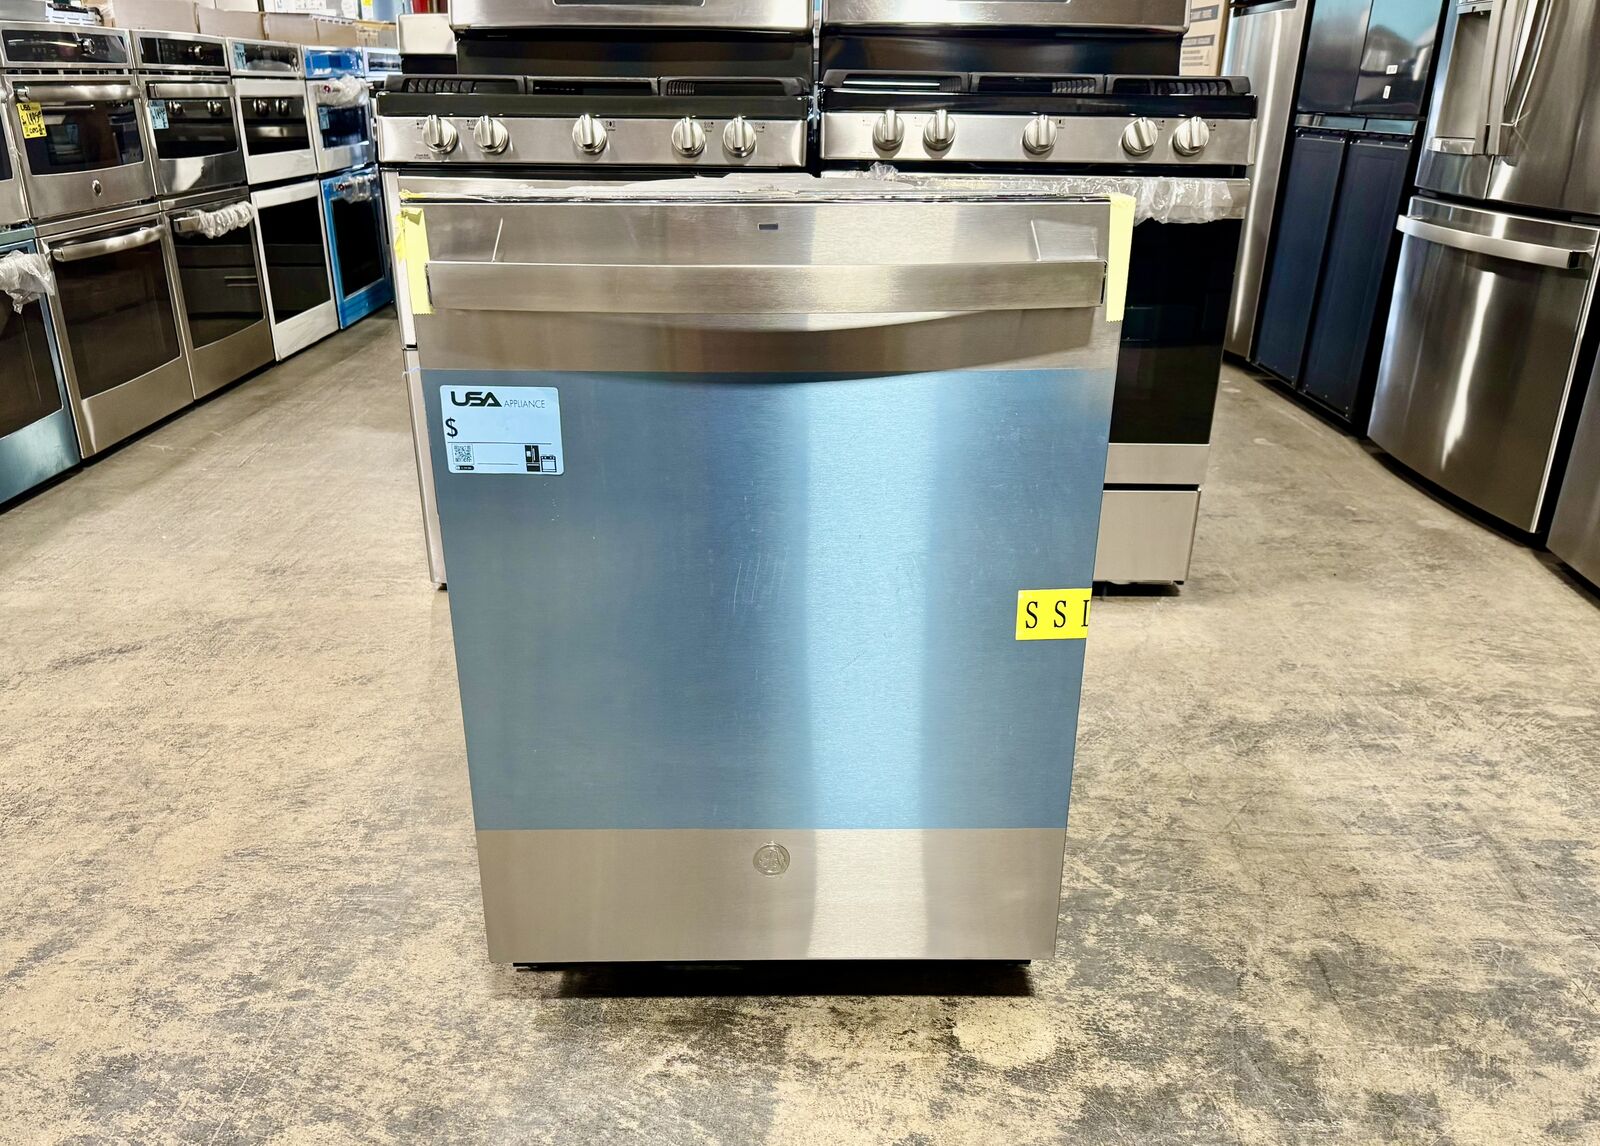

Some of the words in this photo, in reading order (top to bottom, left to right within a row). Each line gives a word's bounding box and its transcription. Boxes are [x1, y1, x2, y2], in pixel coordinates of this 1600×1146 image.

[450, 391, 502, 408] USA
[503, 399, 546, 409] APPLIANCE
[445, 416, 459, 438] $
